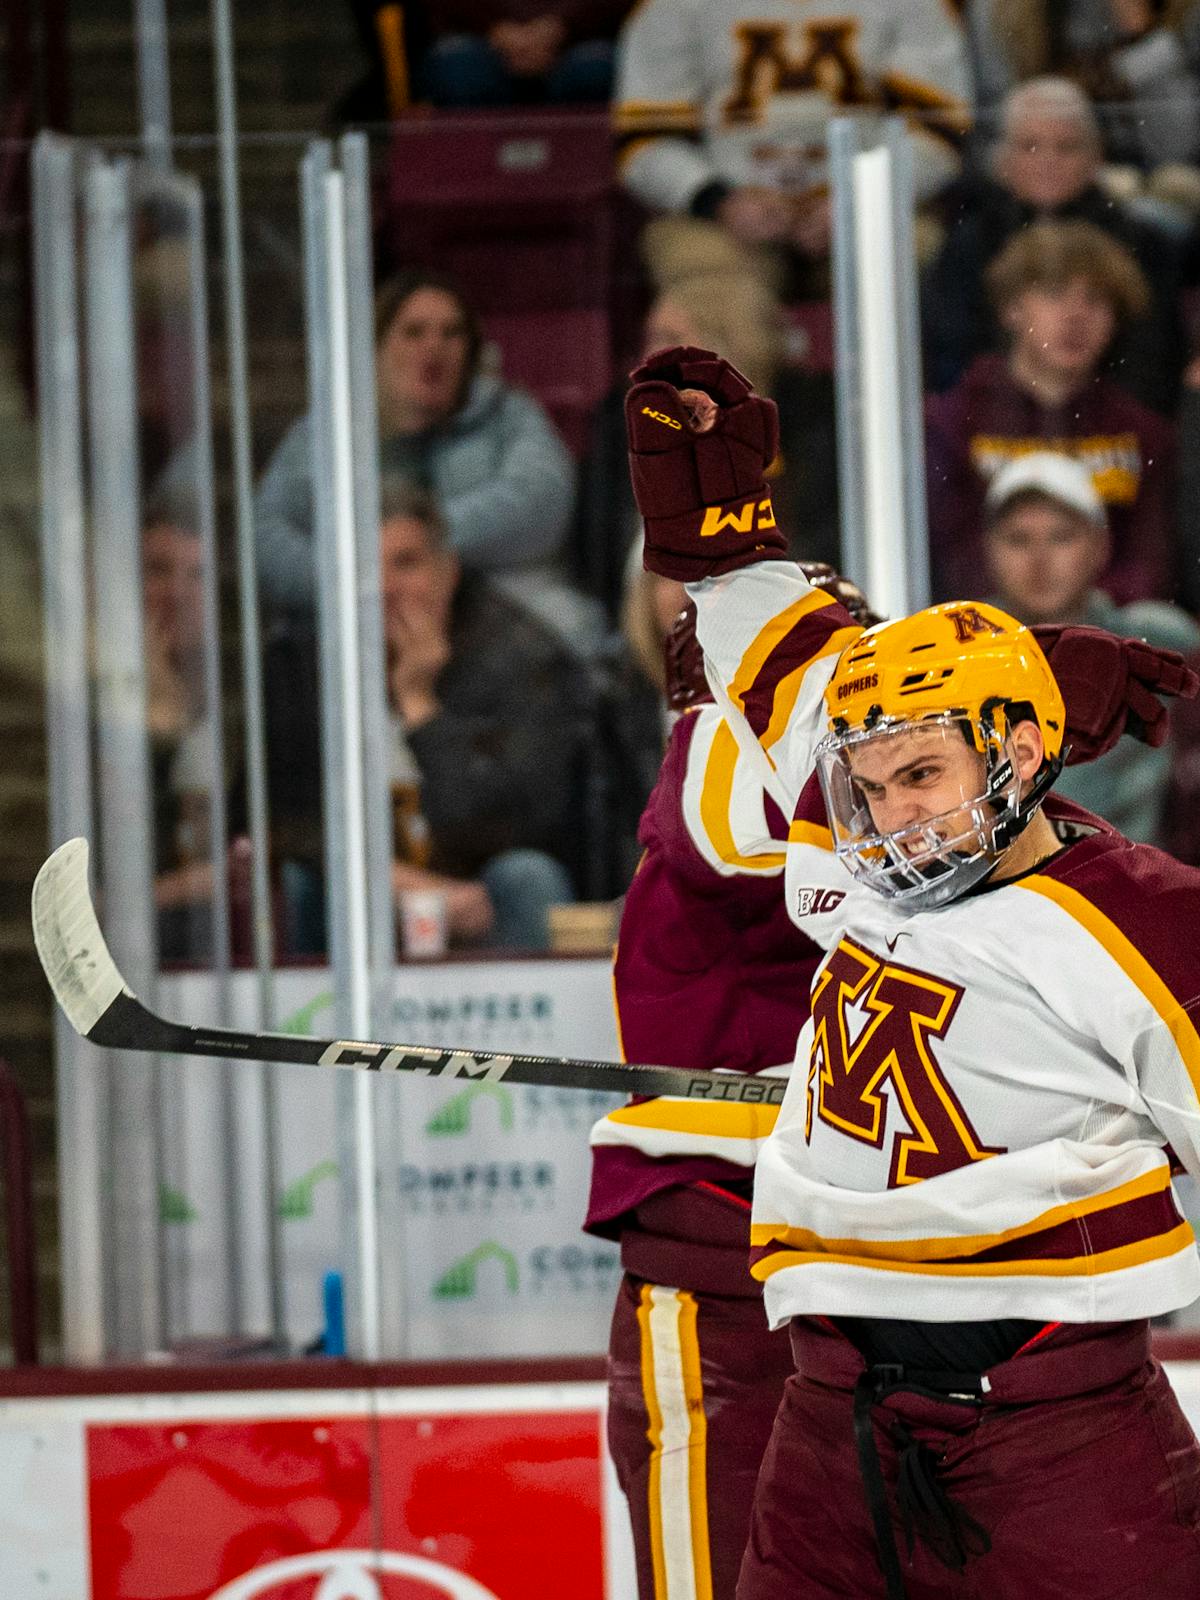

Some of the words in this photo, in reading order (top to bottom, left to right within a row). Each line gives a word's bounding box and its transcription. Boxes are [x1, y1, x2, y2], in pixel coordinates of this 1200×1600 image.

[641, 406, 683, 431] CCM
[700, 498, 776, 537] CM
[837, 673, 879, 701] GOPHERS
[992, 766, 1012, 790] CCM
[318, 1041, 513, 1081] CCM
[805, 931, 1008, 1190] M
